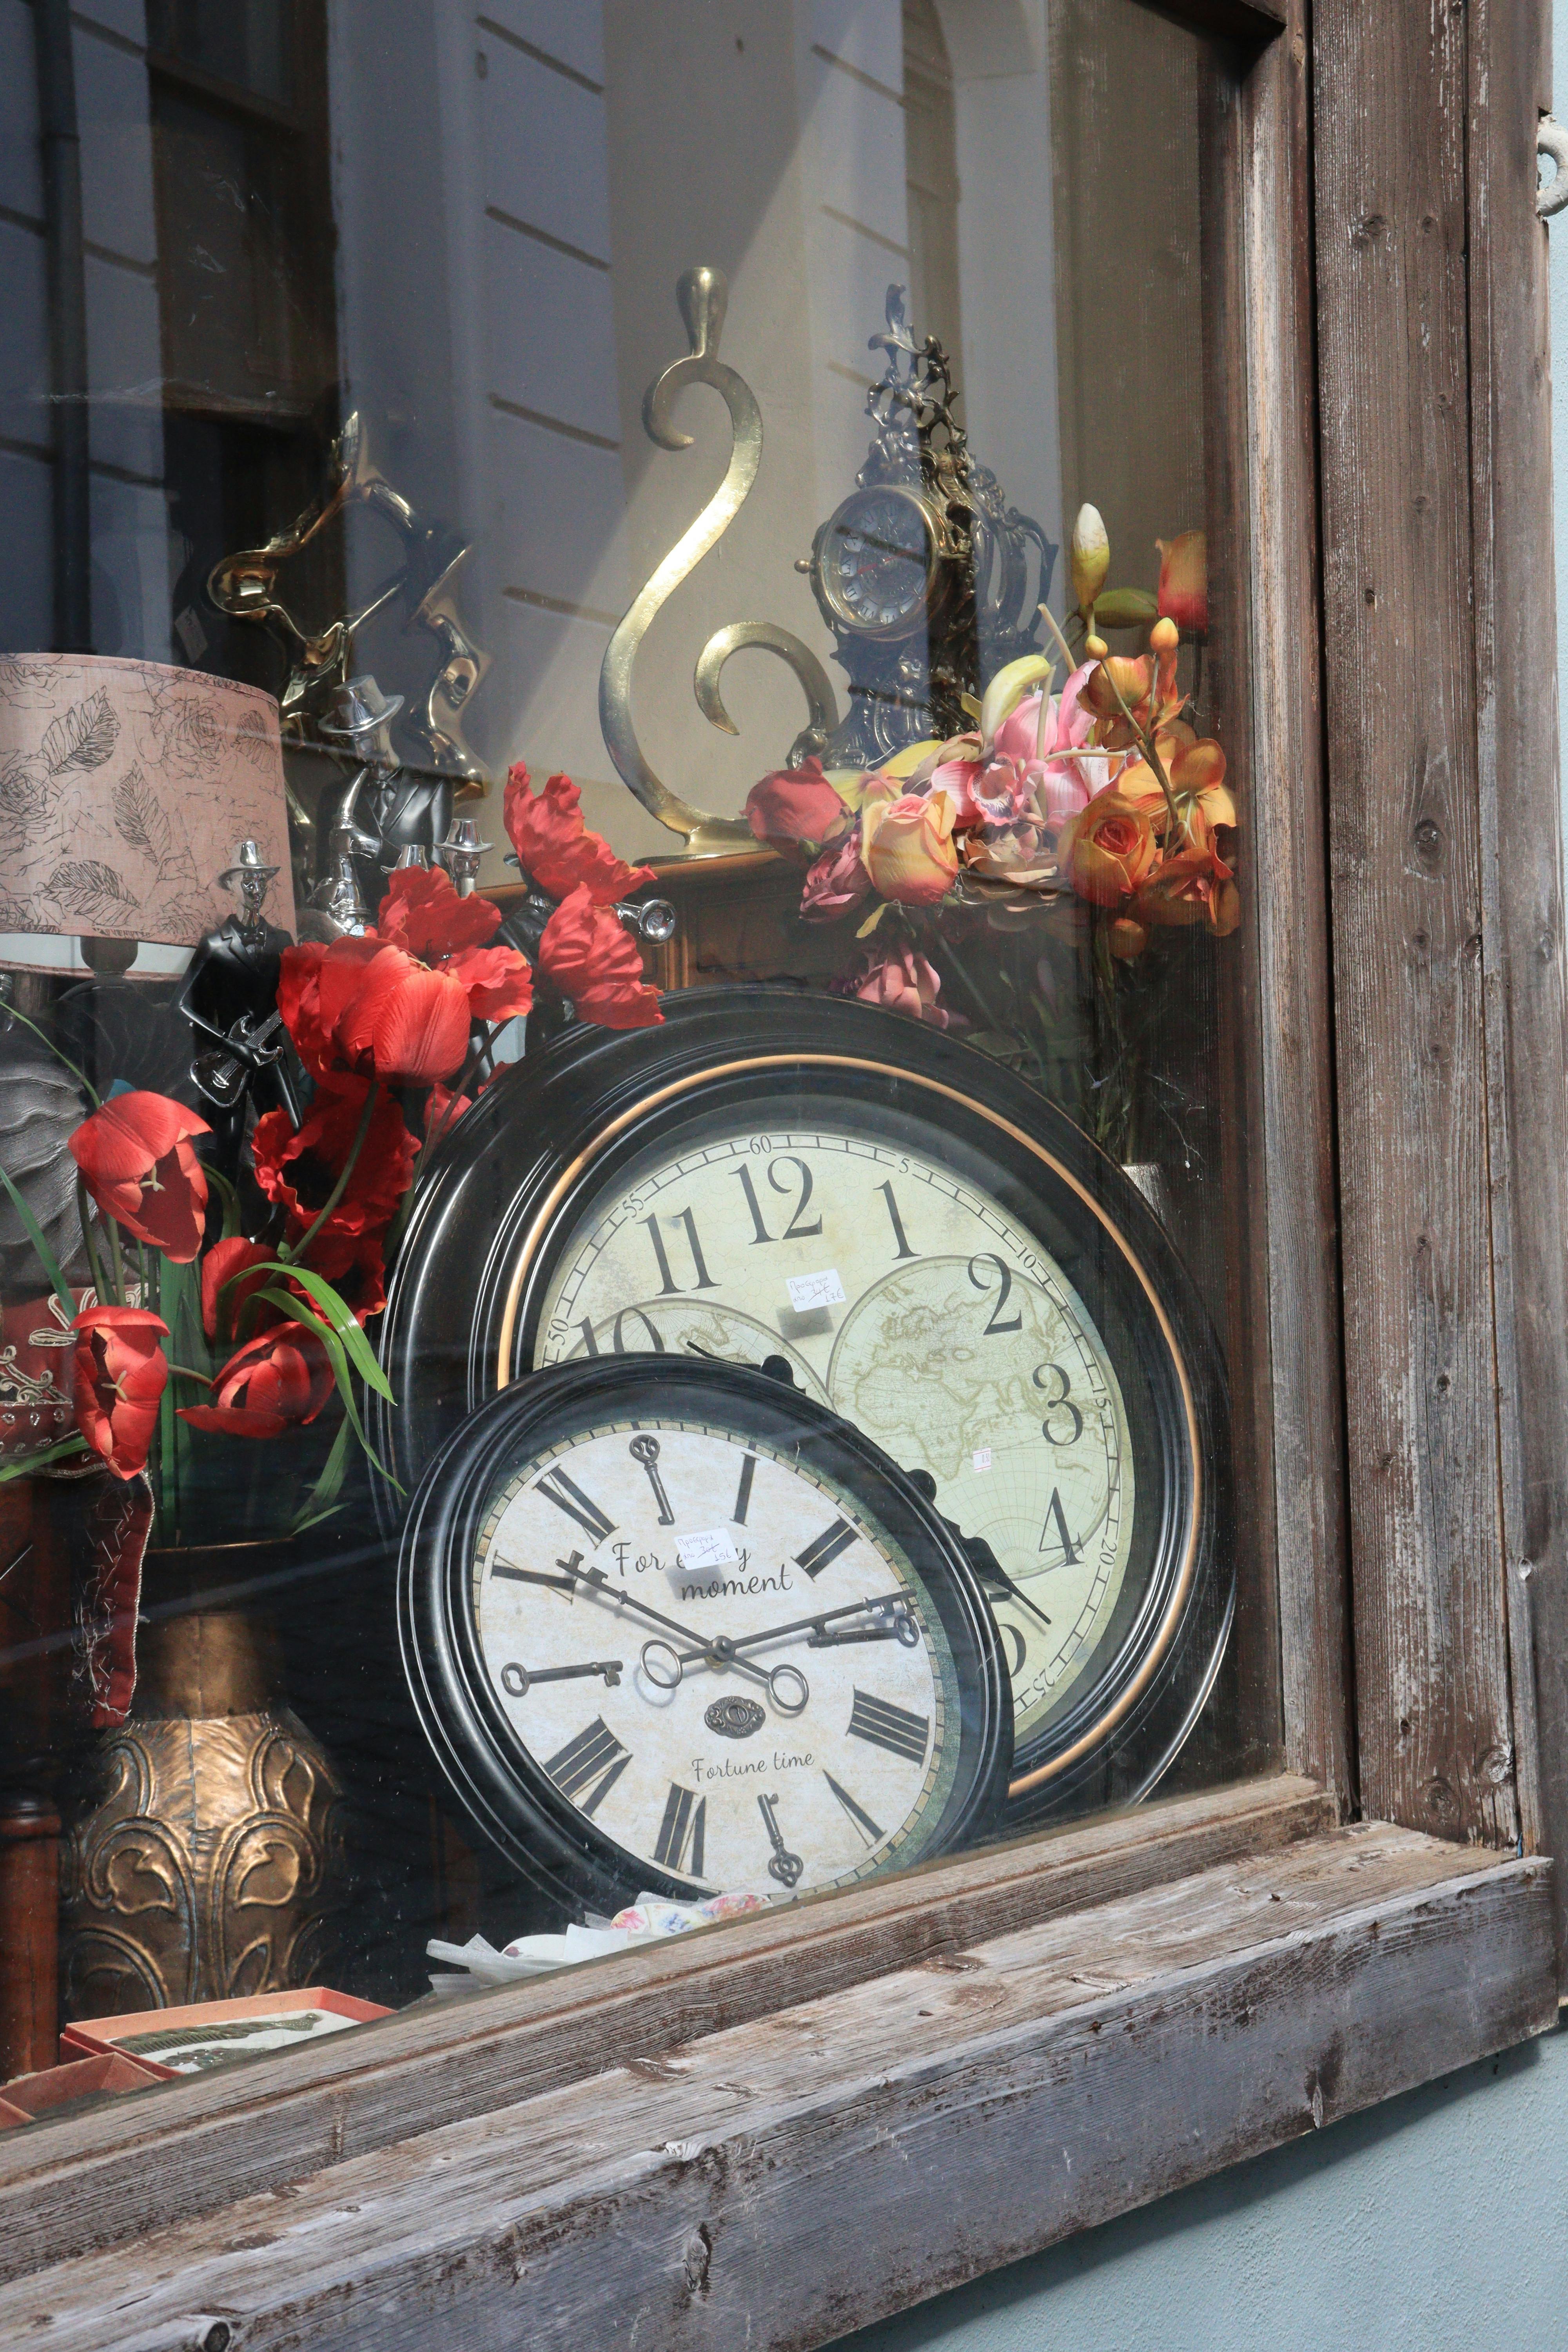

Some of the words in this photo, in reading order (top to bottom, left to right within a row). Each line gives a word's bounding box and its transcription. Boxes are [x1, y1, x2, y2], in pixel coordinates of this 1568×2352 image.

[750, 1135, 771, 1154] 60
[898, 1158, 911, 1174] 5
[623, 1192, 644, 1218] 55
[728, 1156, 823, 1245] 12
[873, 1179, 922, 1260] 1
[635, 1206, 722, 1296] 11
[1016, 1247, 1037, 1269] 10
[825, 1288, 844, 1302] 17€
[967, 1253, 1022, 1335] 2
[548, 1318, 569, 1347] 50
[1033, 1363, 1083, 1446] 3
[1091, 1387, 1112, 1408] 15
[533, 1463, 620, 1550] XI
[730, 1452, 760, 1526] I
[1039, 1487, 1086, 1567] 4
[612, 1541, 666, 1577] For
[715, 1548, 731, 1561] 15€
[791, 1514, 862, 1582] II
[1099, 1538, 1118, 1564] 20
[491, 1550, 579, 1604] X
[681, 1563, 793, 1601] moment
[1033, 1668, 1055, 1697] 25
[691, 1758, 768, 1782] Fortune
[773, 1751, 815, 1770] time
[822, 1769, 888, 1850] V
[648, 1779, 708, 1880] VII
